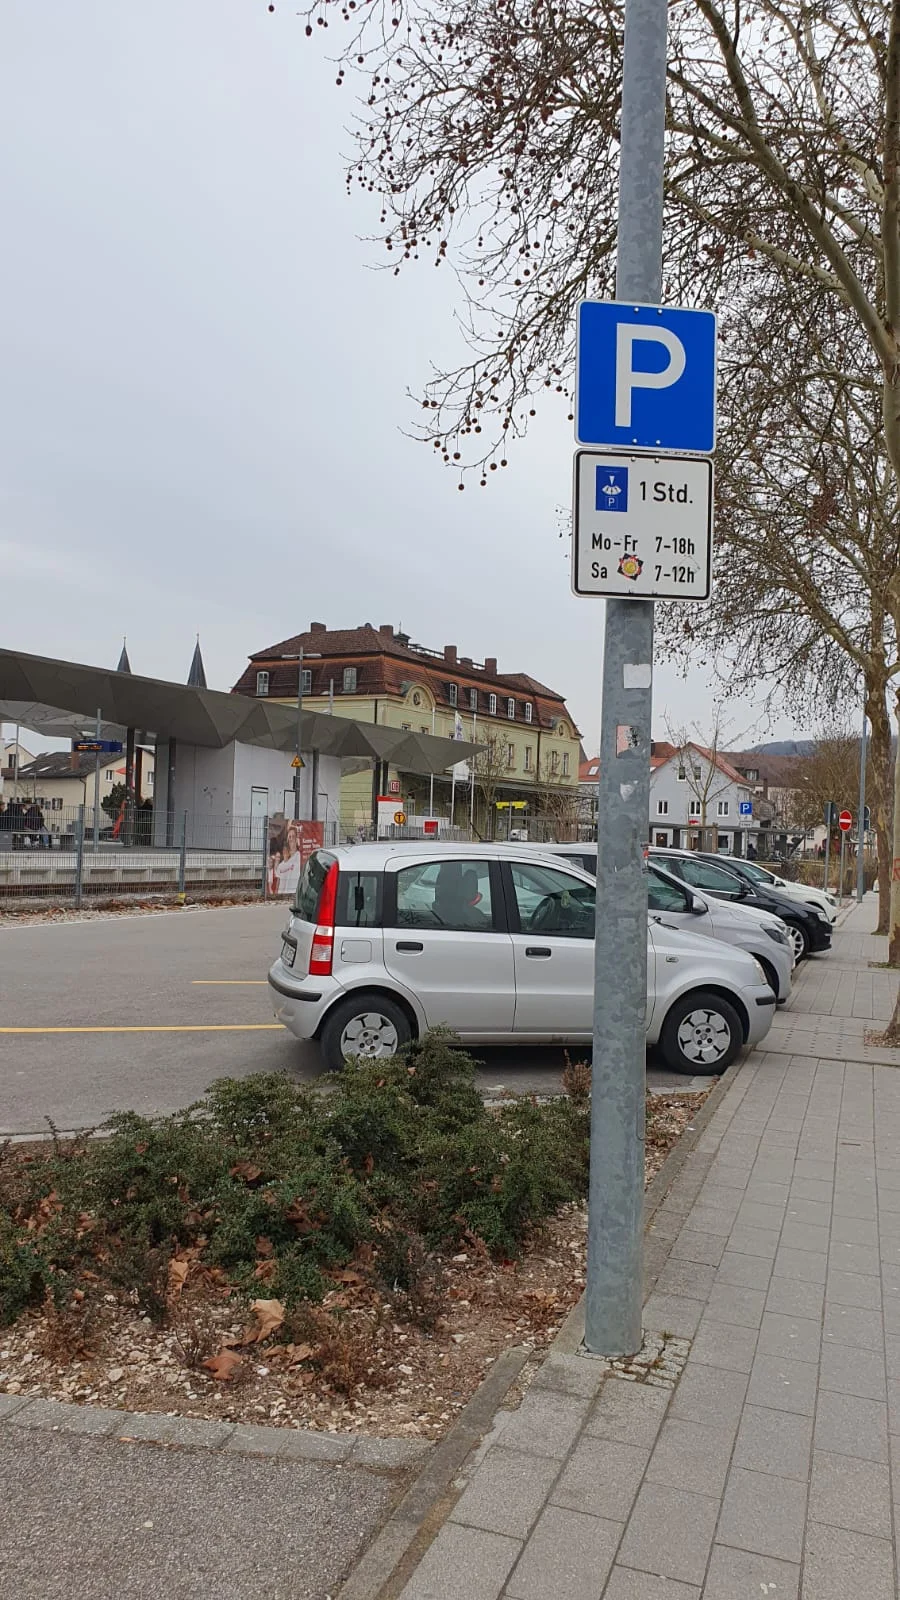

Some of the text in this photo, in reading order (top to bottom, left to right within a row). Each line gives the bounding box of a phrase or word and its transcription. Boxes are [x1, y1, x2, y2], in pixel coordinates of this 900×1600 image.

[615, 322, 687, 428] P
[608, 497, 615, 507] P
[639, 481, 693, 504] 1 Std.
[655, 536, 695, 555] 7-18h
[591, 562, 695, 583] Sa 7-12h
[742, 803, 750, 813] P
